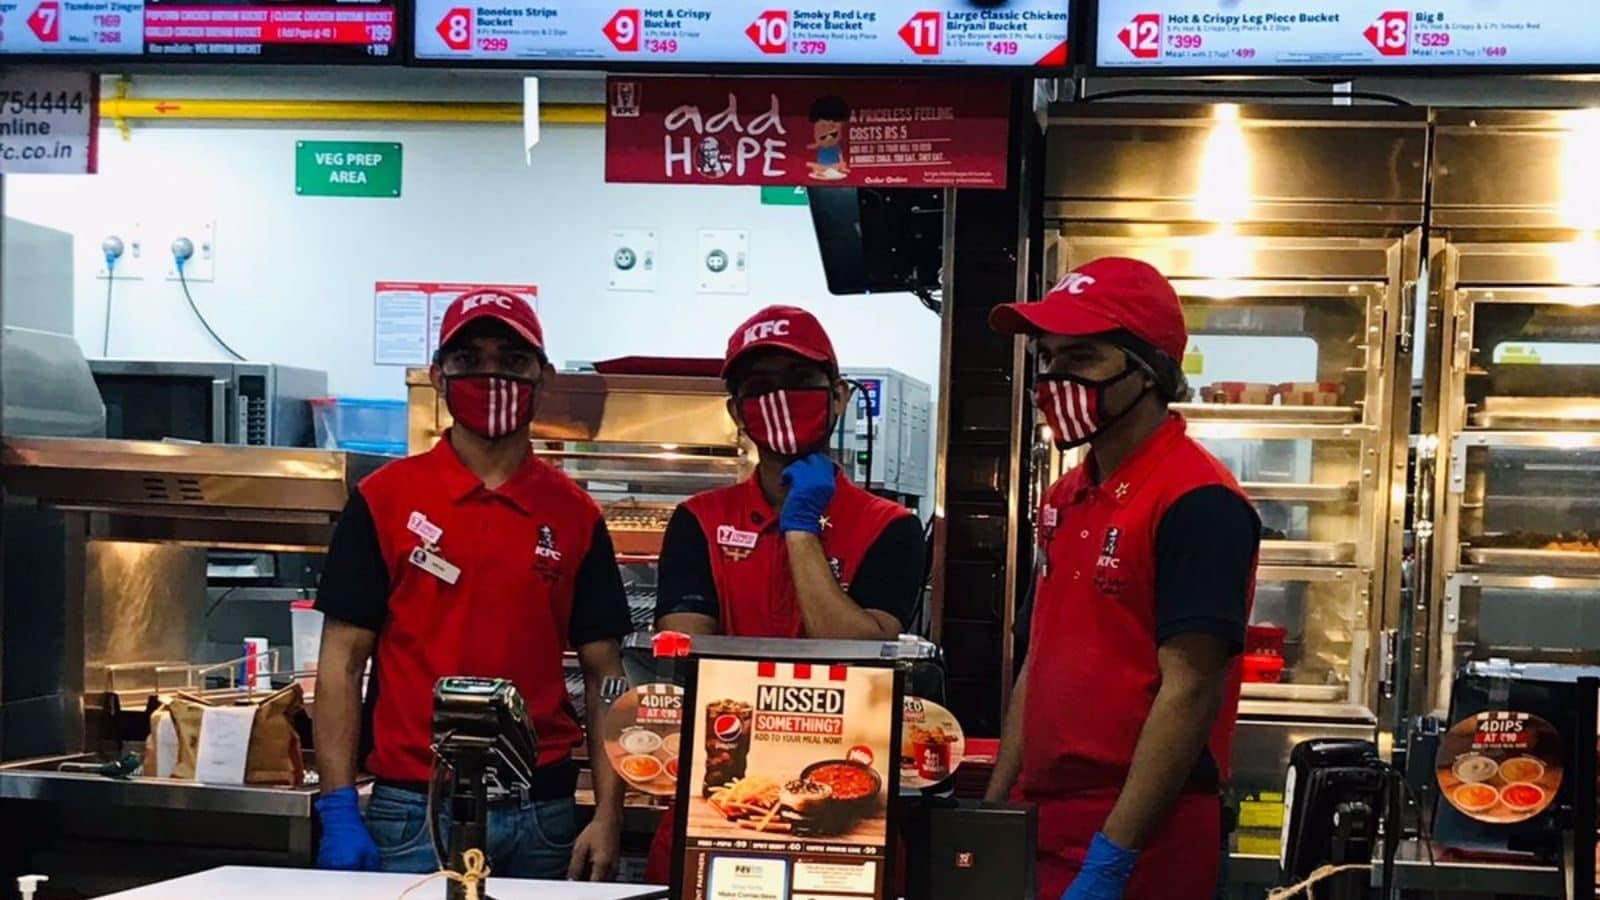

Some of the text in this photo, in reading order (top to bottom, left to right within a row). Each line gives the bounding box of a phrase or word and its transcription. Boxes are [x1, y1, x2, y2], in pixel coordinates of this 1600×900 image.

[478, 8, 557, 18] Boneless Strips
[645, 9, 711, 20] Hot & Crispy
[793, 10, 876, 21] Smoky Red Leg
[947, 11, 1067, 22] Large Classic Chicken
[1168, 14, 1339, 25] Hot & Crispy Leg Piece Bucket
[1416, 12, 1444, 23] Big 8
[38, 9, 56, 34] 7
[478, 18, 512, 26] Bucket
[644, 20, 681, 28] Bucket
[793, 21, 862, 30] Piece Bucket
[947, 22, 1027, 32] Biryani Bucket
[448, 15, 467, 42] 8
[616, 16, 634, 44] 9
[755, 18, 788, 46] 10
[911, 19, 936, 47] 11
[1376, 18, 1406, 47] 13
[1124, 21, 1159, 50] 12
[1168, 35, 1202, 48] ₹399
[1415, 33, 1450, 47] ₹529
[478, 38, 508, 50] ₹299
[644, 40, 677, 52] ₹349
[793, 41, 826, 54] ₹379
[986, 41, 1018, 54] ₹419
[664, 93, 786, 135] add
[850, 110, 858, 122] A
[850, 125, 908, 140] COSTS RS 5
[315, 153, 382, 166] VEG PREP
[329, 170, 367, 184] AREA
[460, 293, 512, 314] KFC
[743, 319, 790, 346] KFC
[535, 545, 562, 560] KFC
[1096, 556, 1120, 568] KFC
[759, 686, 841, 713] MISSED
[647, 708, 658, 717] AT
[757, 716, 840, 733] SOMETHING?
[803, 735, 820, 744] MEAL
[1484, 733, 1497, 742] AT
